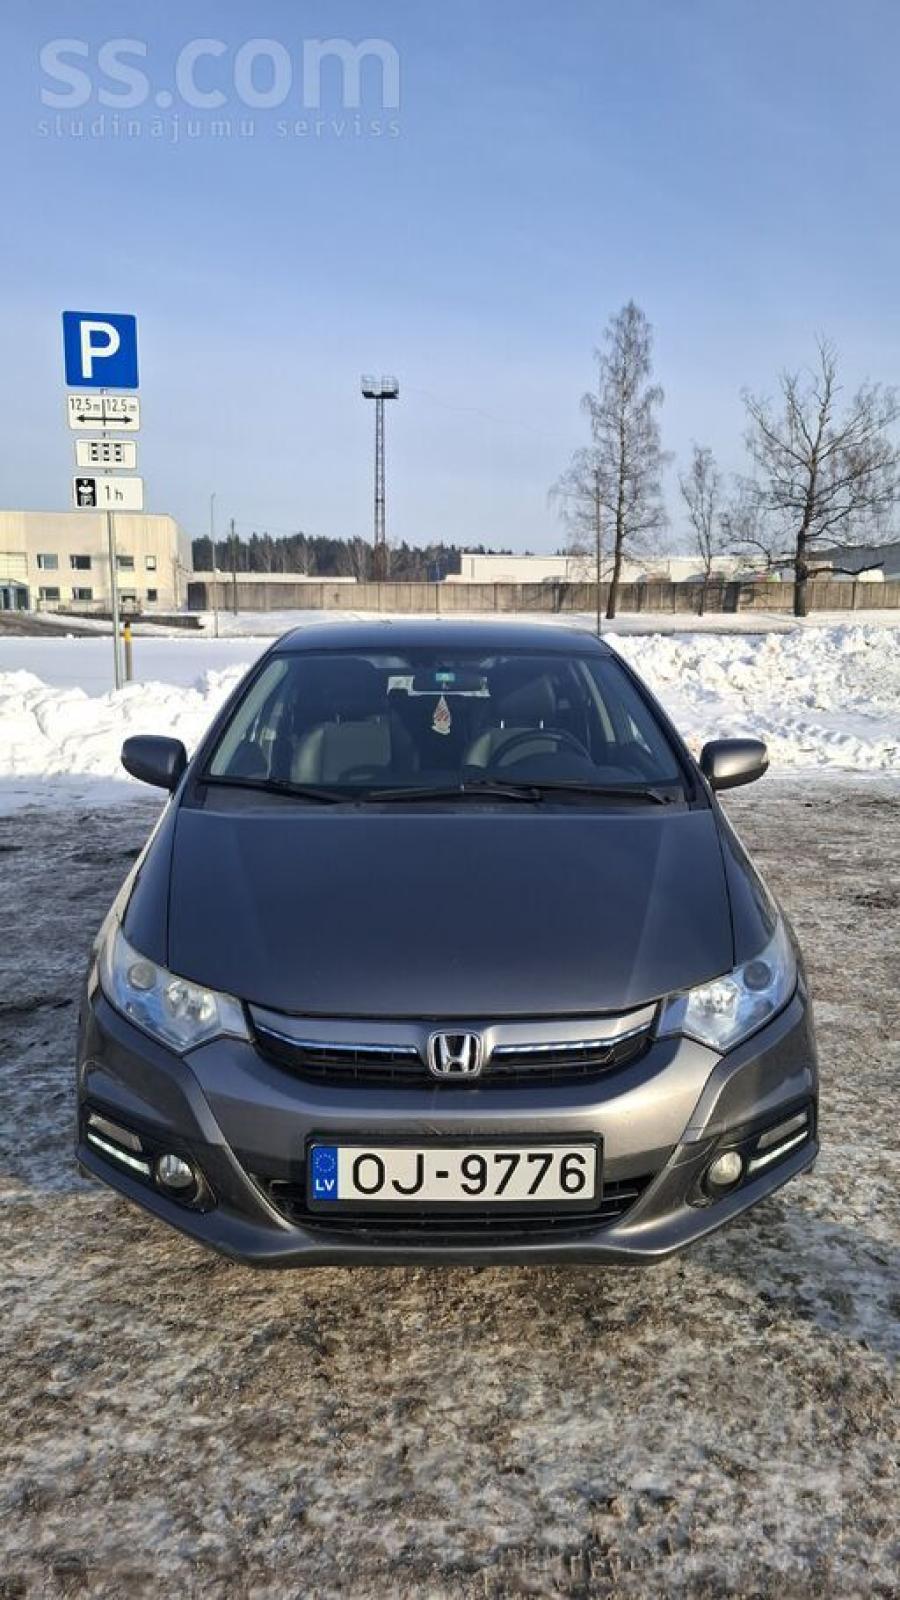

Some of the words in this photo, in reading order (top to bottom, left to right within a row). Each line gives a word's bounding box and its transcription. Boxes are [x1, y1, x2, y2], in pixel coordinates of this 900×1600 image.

[80, 320, 121, 378] P
[105, 485, 110, 501] 1
[115, 487, 124, 501] h
[437, 1032, 473, 1075] H
[315, 1180, 334, 1191] LV
[353, 1153, 587, 1195] OJ-9776
